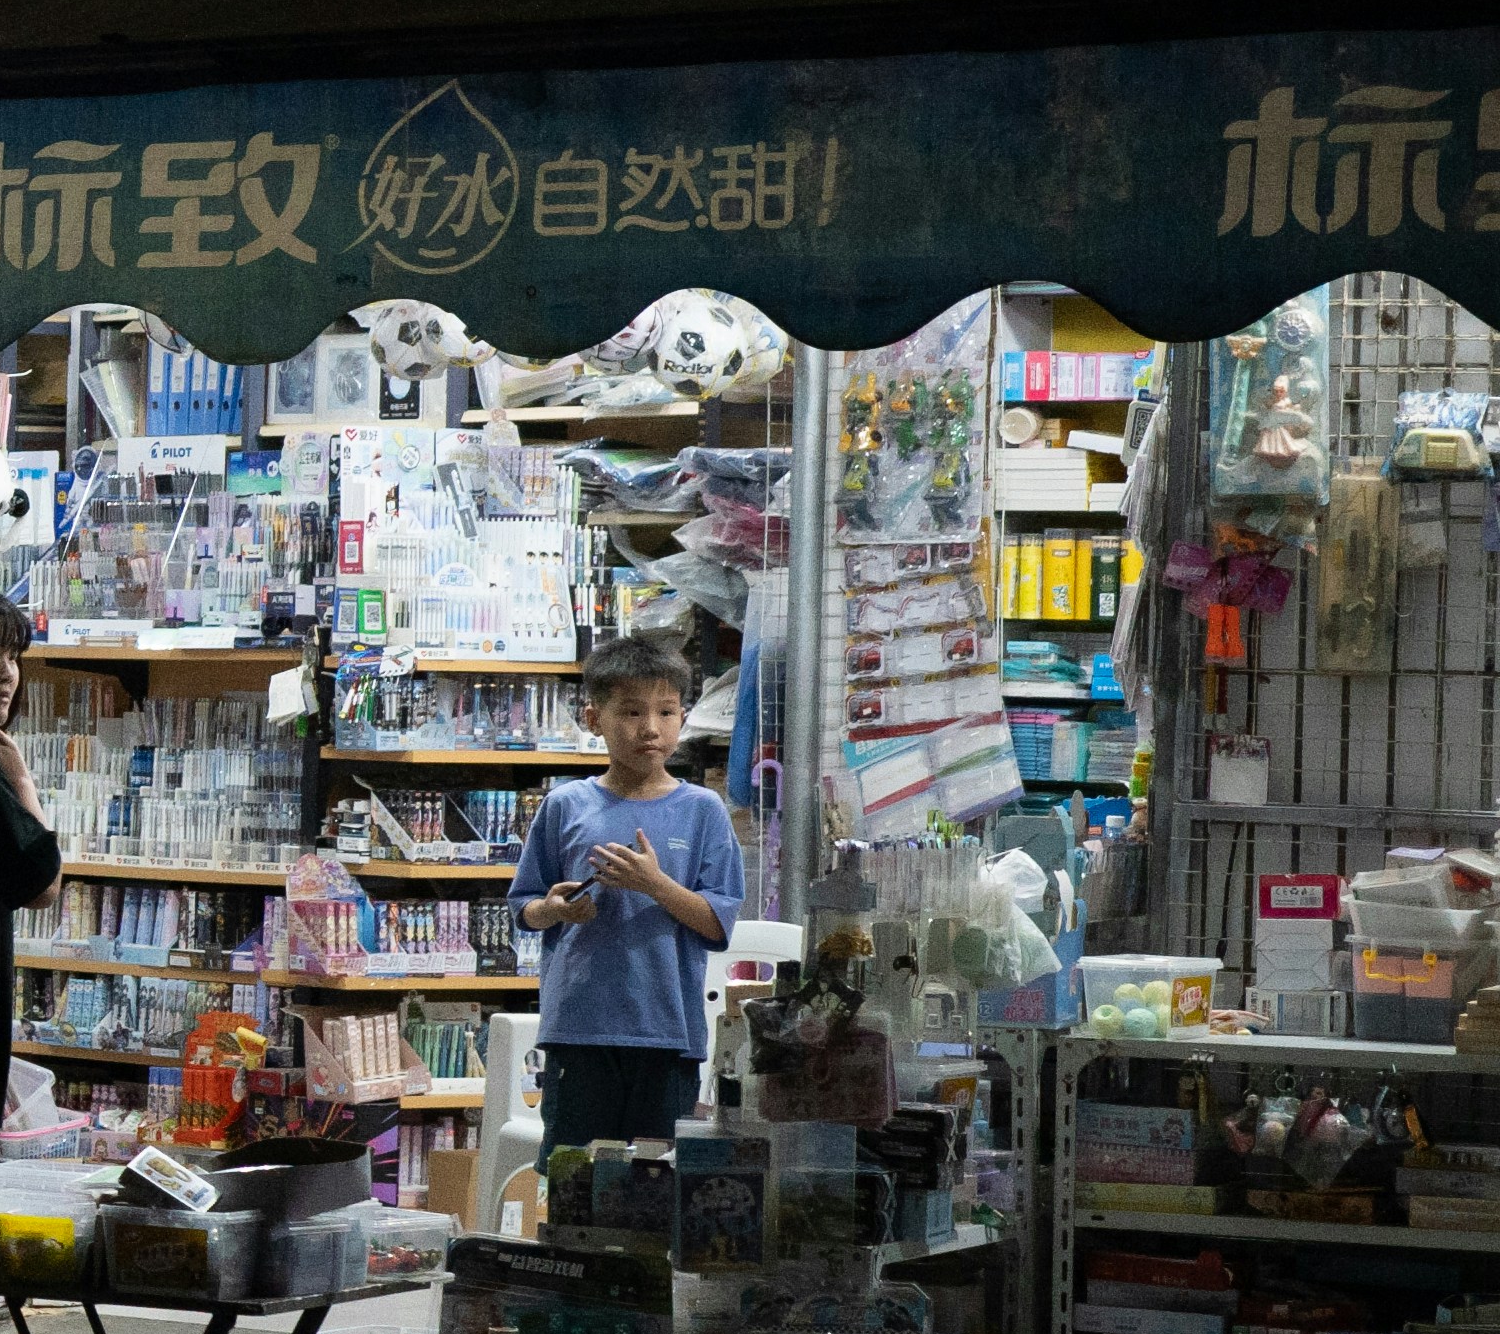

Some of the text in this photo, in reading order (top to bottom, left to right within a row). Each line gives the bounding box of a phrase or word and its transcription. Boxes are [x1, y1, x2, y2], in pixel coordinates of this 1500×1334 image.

[1219, 86, 1500, 239] 标
[342, 153, 512, 253] 好水
[359, 430, 378, 442] 爱好
[468, 434, 482, 444] 爱好
[162, 447, 192, 458] PILOT
[72, 628, 90, 636] PILOT
